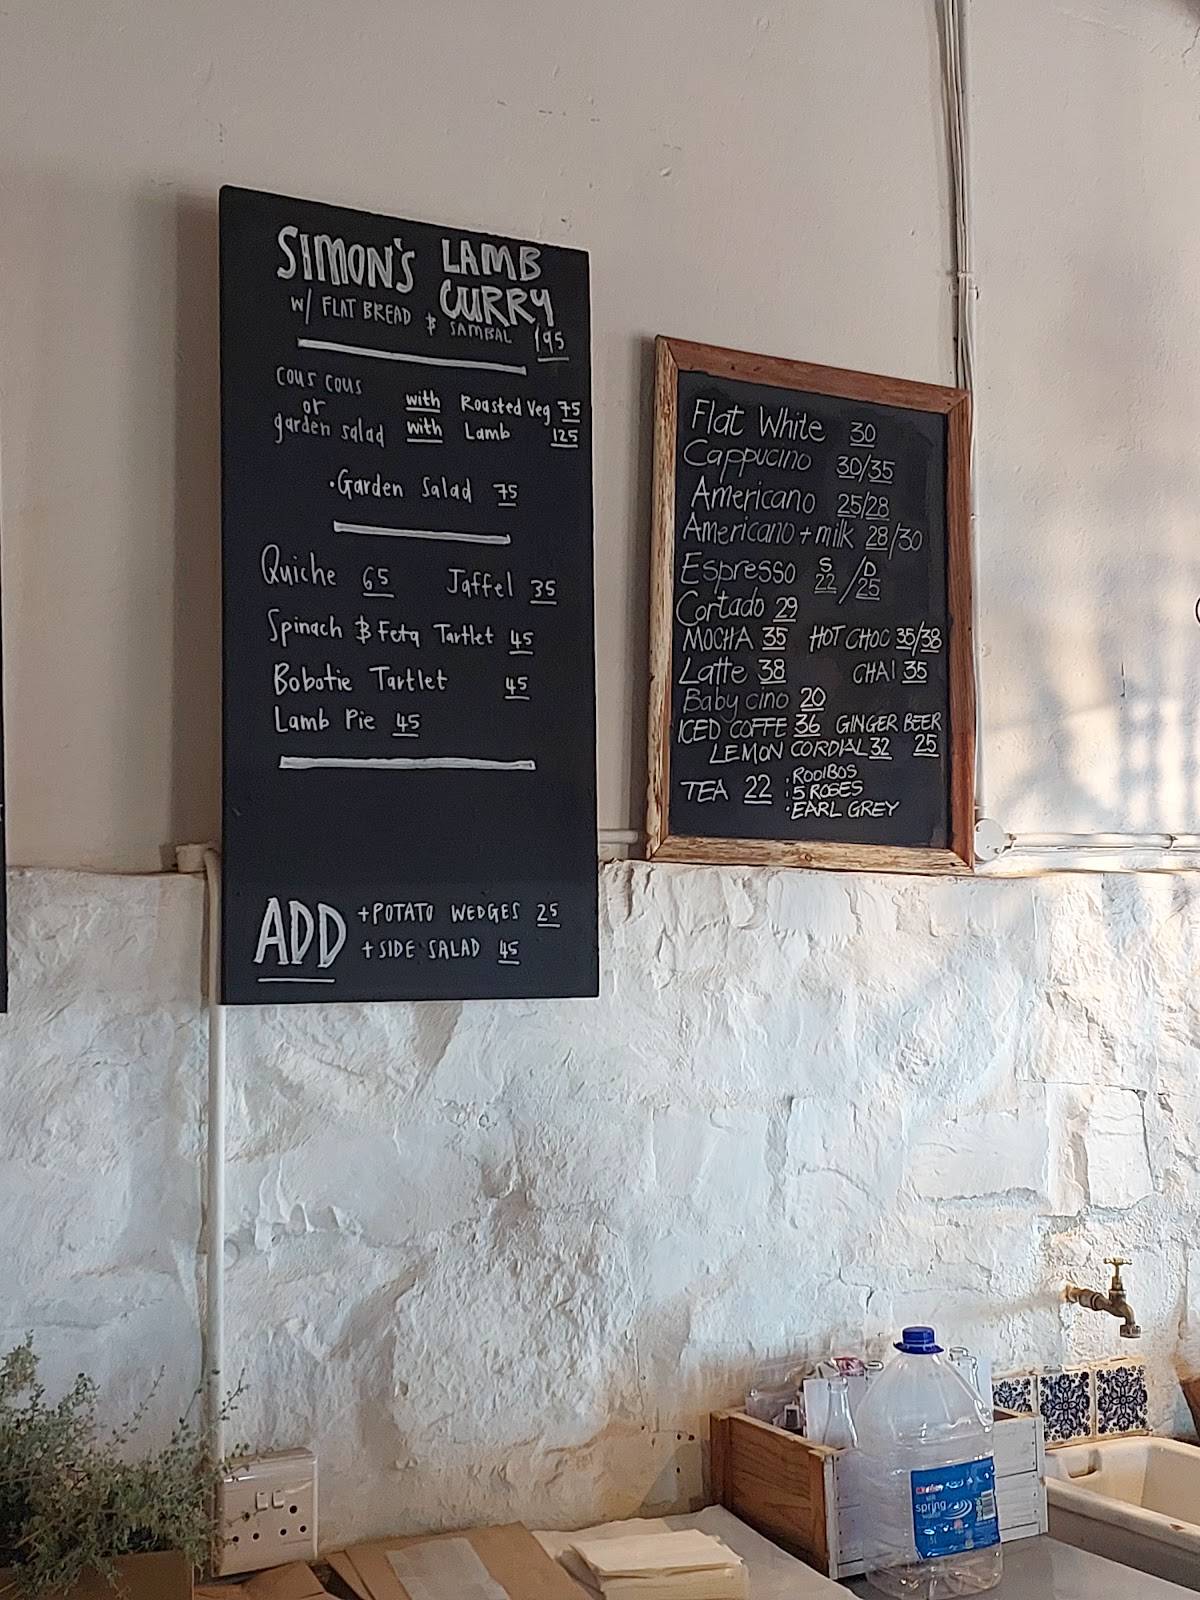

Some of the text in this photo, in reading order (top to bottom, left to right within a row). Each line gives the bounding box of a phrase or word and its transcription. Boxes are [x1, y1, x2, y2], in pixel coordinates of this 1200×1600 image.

[276, 225, 542, 294] SIMON'S LAMB
[439, 279, 556, 328] CURRY
[322, 296, 357, 319] FLAT
[363, 300, 412, 326] BREAD
[450, 320, 513, 344] SAMBAL
[534, 324, 565, 354] 195
[303, 398, 327, 416] or
[406, 390, 581, 426] with Roasted Veg 75
[691, 398, 876, 443] Flat White 30
[274, 413, 385, 448] garden salad
[407, 417, 578, 444] with Lamb 125
[683, 439, 895, 484] Cappucino 30/35
[422, 476, 472, 504] Salad
[493, 483, 518, 500] 75
[690, 475, 890, 520] Americano 25/28
[865, 521, 923, 561] 28/30
[261, 544, 390, 591] Quiche 65
[681, 552, 796, 594] Espresso
[446, 568, 557, 600] Jaffel 35
[814, 574, 882, 598] 22 25
[676, 587, 798, 627] Cortado 29
[267, 608, 343, 648] Spinach
[377, 619, 420, 648] Feta
[433, 623, 496, 646] Tartlet
[510, 630, 534, 650] 45
[682, 626, 788, 652] MOCHA 35
[809, 624, 846, 652] HOT
[846, 628, 890, 651] CHOC
[273, 662, 528, 696] Bobotie Tartlet 45
[679, 657, 786, 684] Latte 38
[853, 660, 927, 684] CHAI 35
[274, 706, 421, 733] Lamb Pie 45
[683, 687, 826, 723] Baby cino 20
[678, 714, 821, 744] ICED COFFE 36
[836, 713, 942, 736] GINGER BEER
[709, 737, 890, 765] LEMON CORDIAL 32
[914, 734, 938, 754] 25
[681, 774, 772, 802] TEA 22
[810, 781, 864, 800] ROSES
[790, 801, 900, 820] EARL GREY
[450, 901, 520, 923] WEDGES
[537, 903, 560, 922] 25
[253, 897, 347, 969] ADD
[428, 938, 480, 959] SALAD
[498, 940, 519, 960] 45
[915, 1500, 947, 1517] spring
